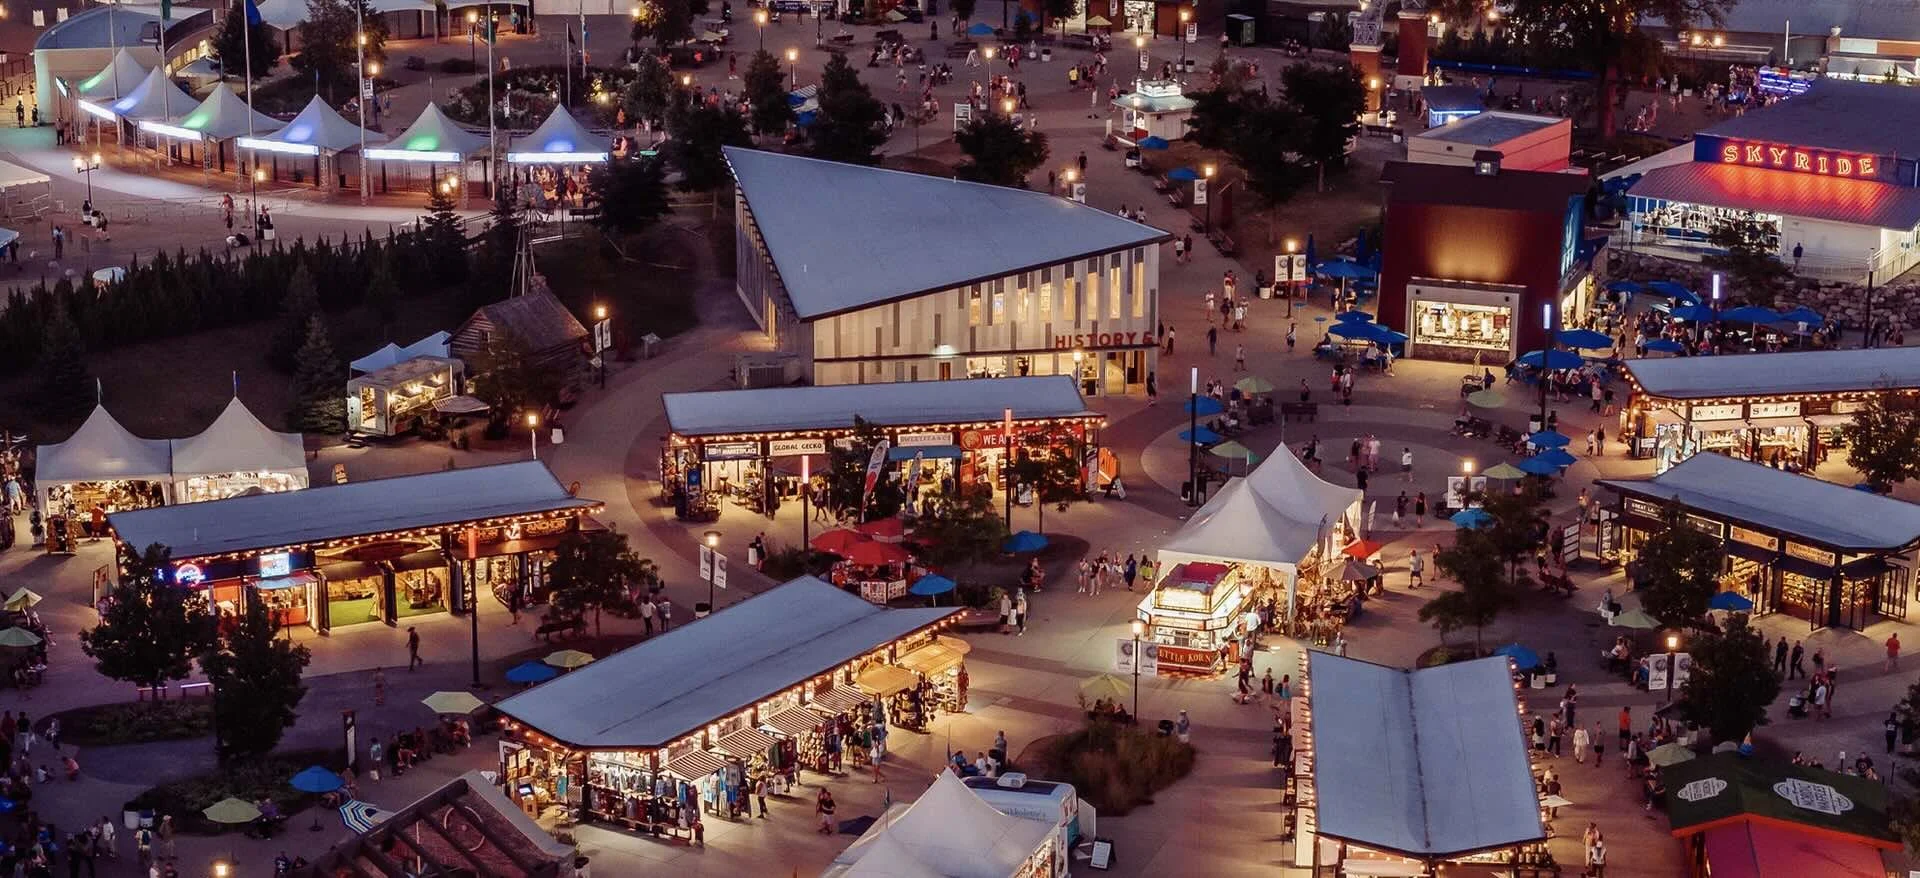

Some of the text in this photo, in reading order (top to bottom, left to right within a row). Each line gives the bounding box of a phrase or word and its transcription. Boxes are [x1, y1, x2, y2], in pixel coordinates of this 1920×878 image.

[1723, 144, 1875, 175] SKYRIDE
[1055, 331, 1137, 349] HISTORY
[982, 434, 997, 446] WE
[774, 442, 822, 452] GLOBAL GECKO
[527, 519, 567, 533] ANCHOR
[1187, 653, 1211, 664] KORN
